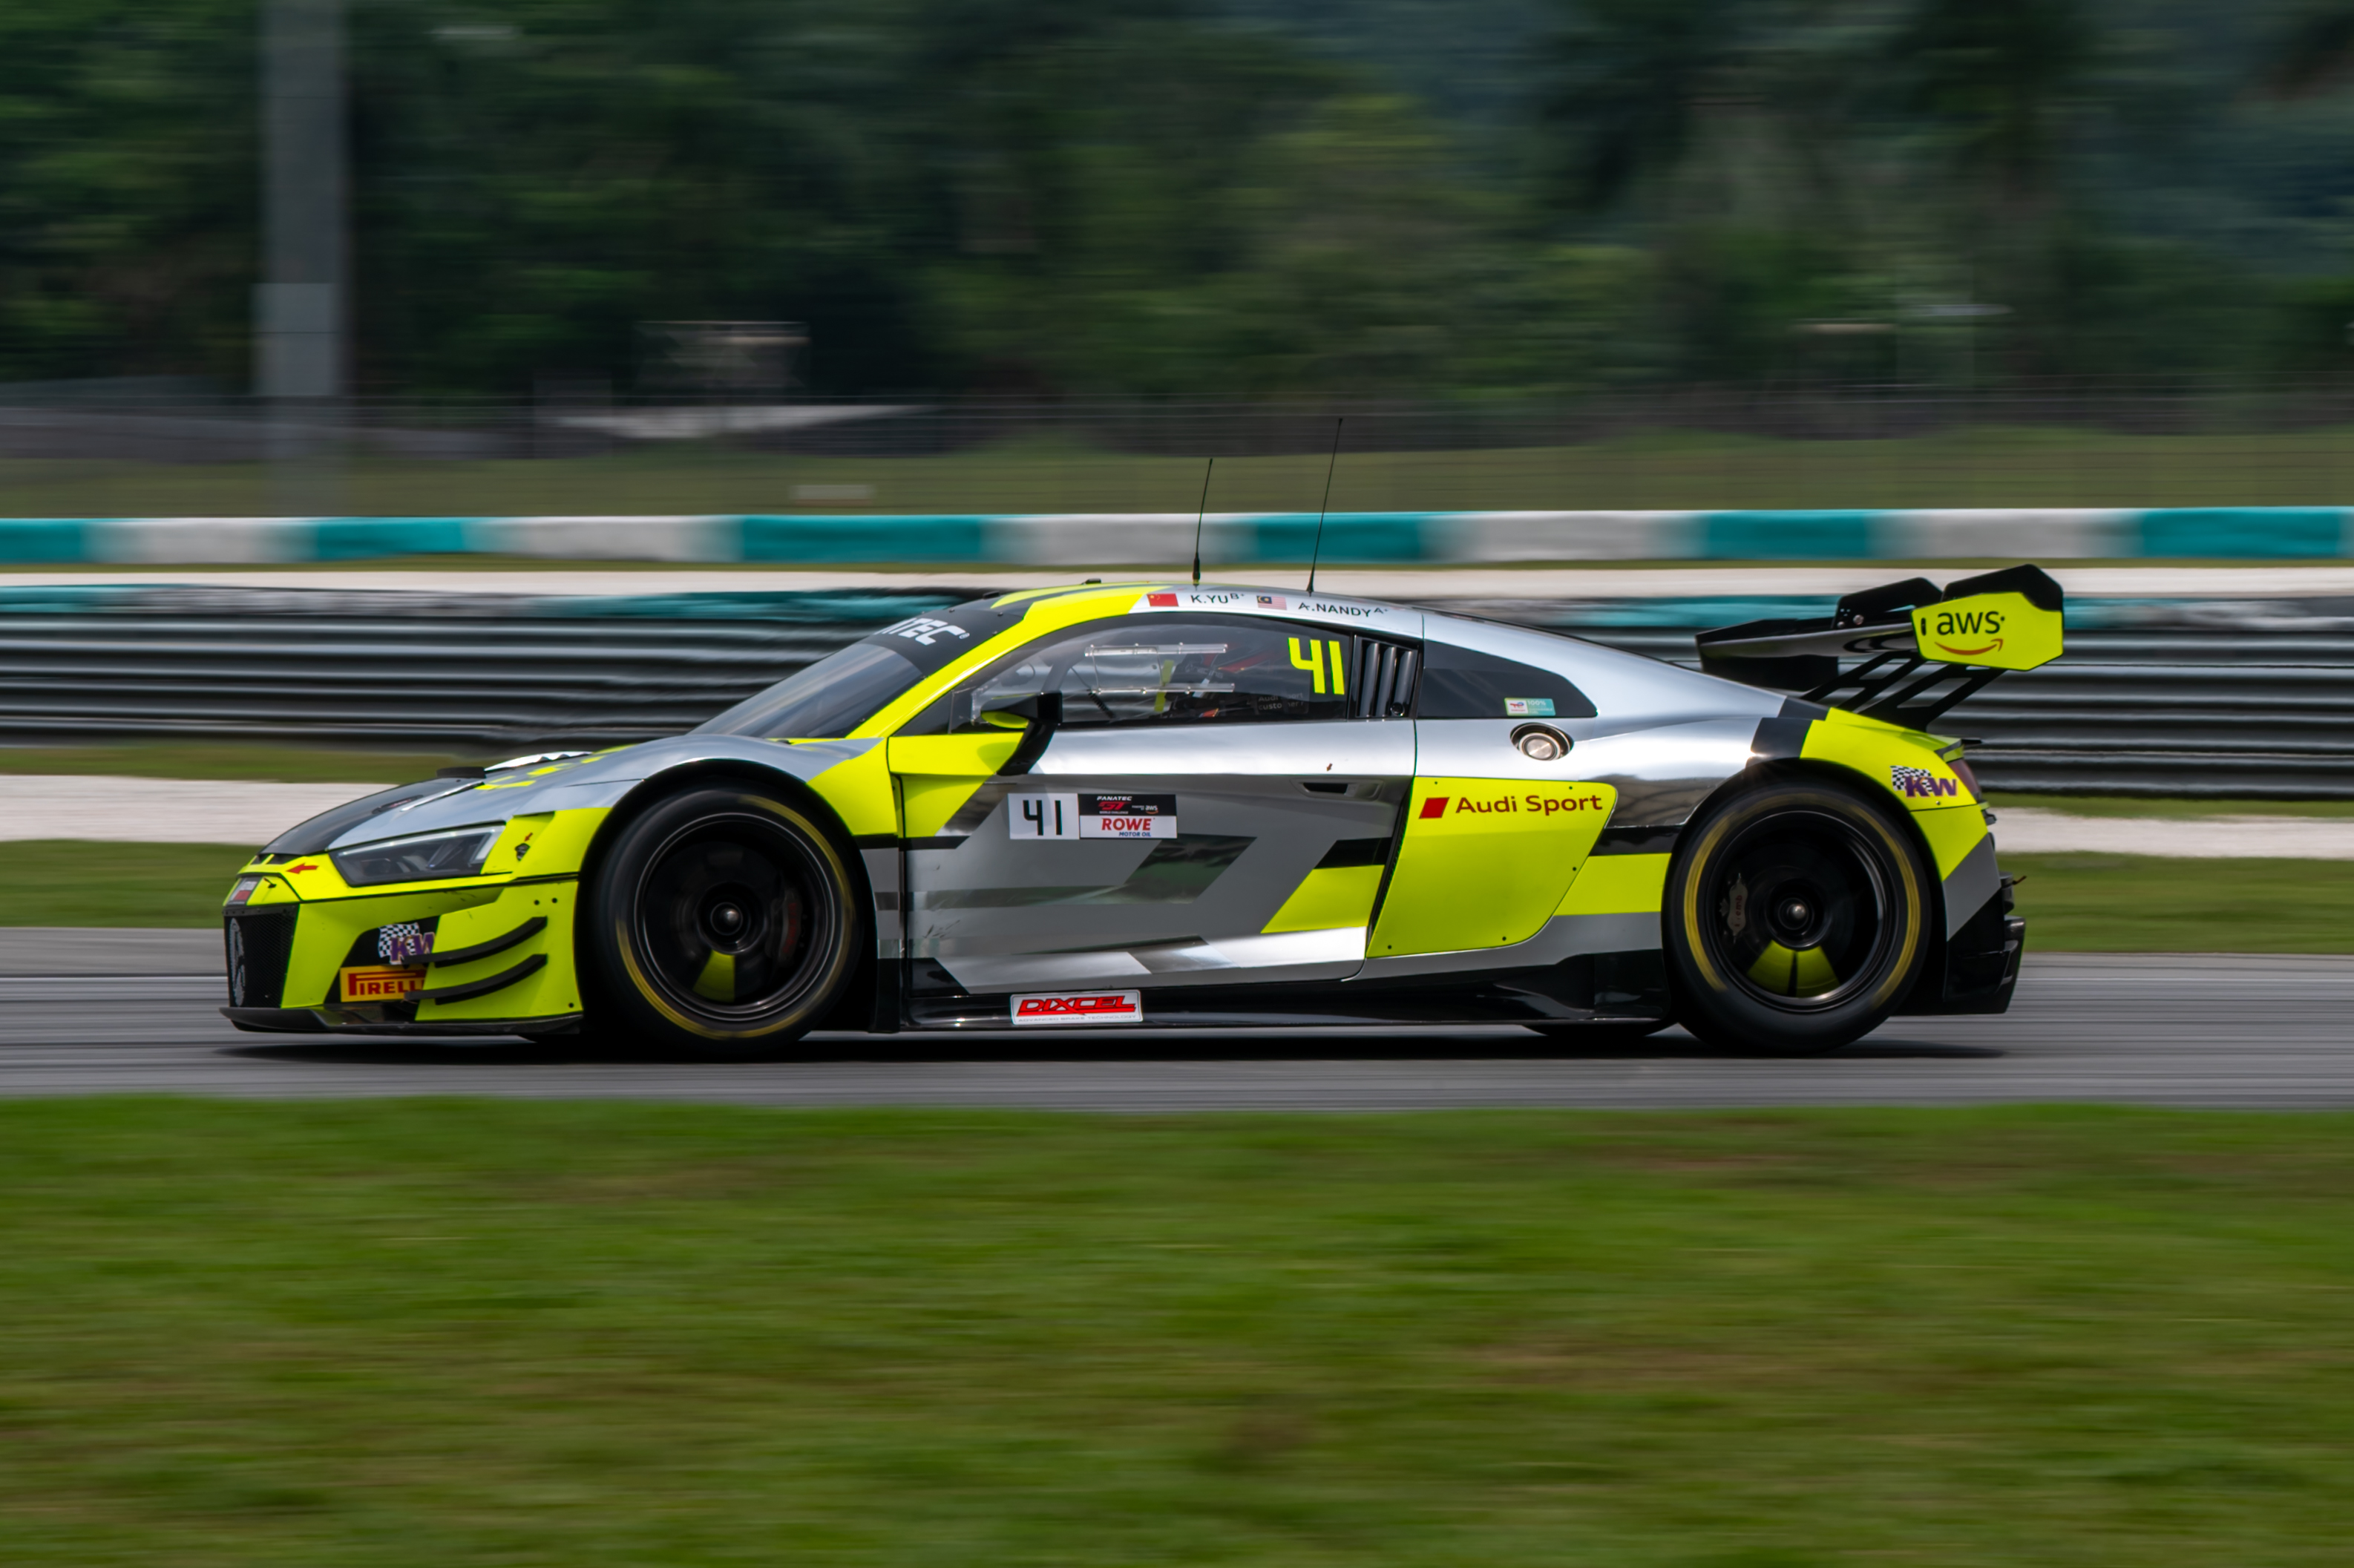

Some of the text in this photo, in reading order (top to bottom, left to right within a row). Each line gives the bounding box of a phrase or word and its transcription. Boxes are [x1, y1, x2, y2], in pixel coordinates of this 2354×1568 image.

[1936, 610, 2002, 636] aws
[1288, 637, 1345, 695] 41
[1905, 776, 1958, 798] KW
[1023, 799, 1063, 836] 41
[1455, 795, 1603, 816] Audi Sport
[1101, 818, 1152, 831] ROWE
[348, 969, 427, 997] PIRELL
[1017, 995, 1137, 1017] DIXCEL
